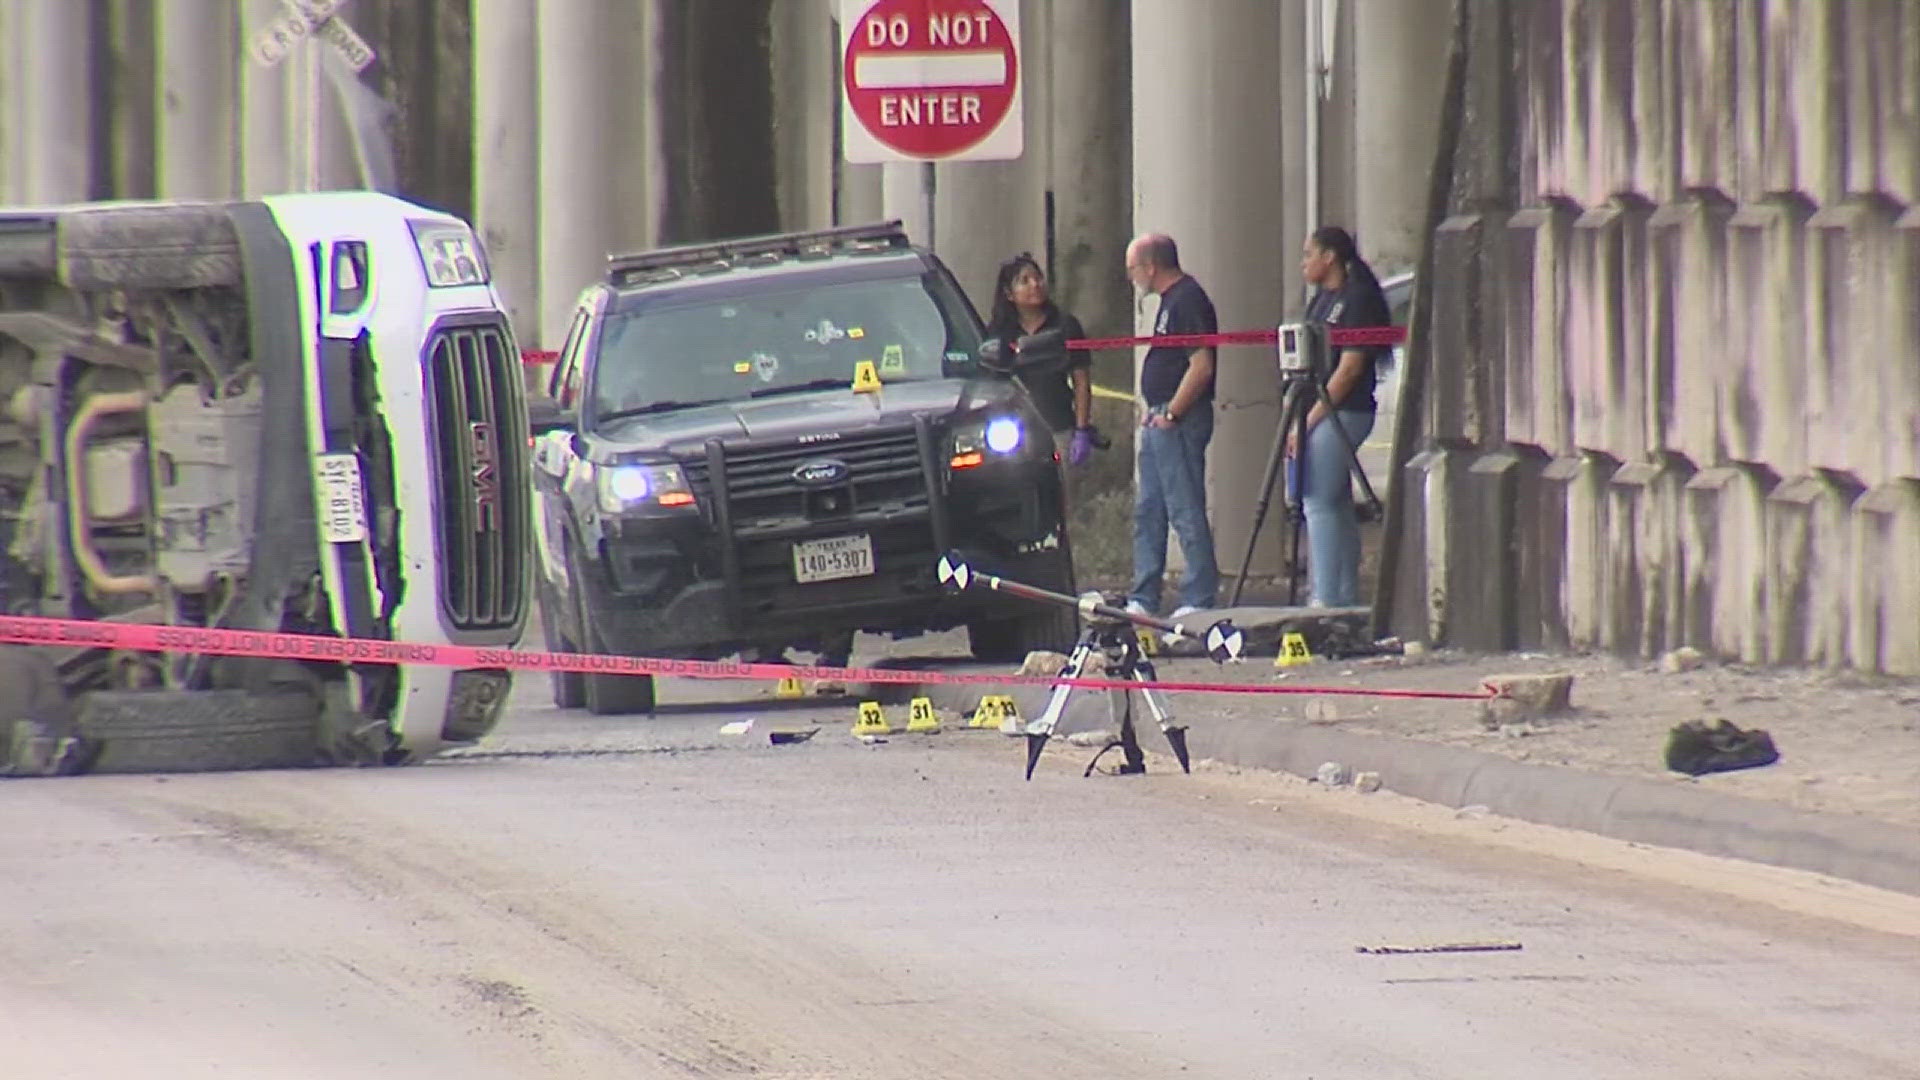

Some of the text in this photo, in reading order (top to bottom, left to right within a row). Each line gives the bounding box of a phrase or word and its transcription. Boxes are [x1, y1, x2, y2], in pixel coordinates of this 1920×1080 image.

[867, 13, 992, 47] DO NOT
[880, 94, 981, 127] ENTER
[862, 368, 871, 382] 4
[470, 421, 500, 532] GMC
[156, 630, 437, 662] CRIME SCENE DO NOT CROSS
[474, 649, 753, 676] CRIME SCENE DO NOT CROSS
[863, 709, 881, 725] 32
[913, 703, 929, 720] 31
